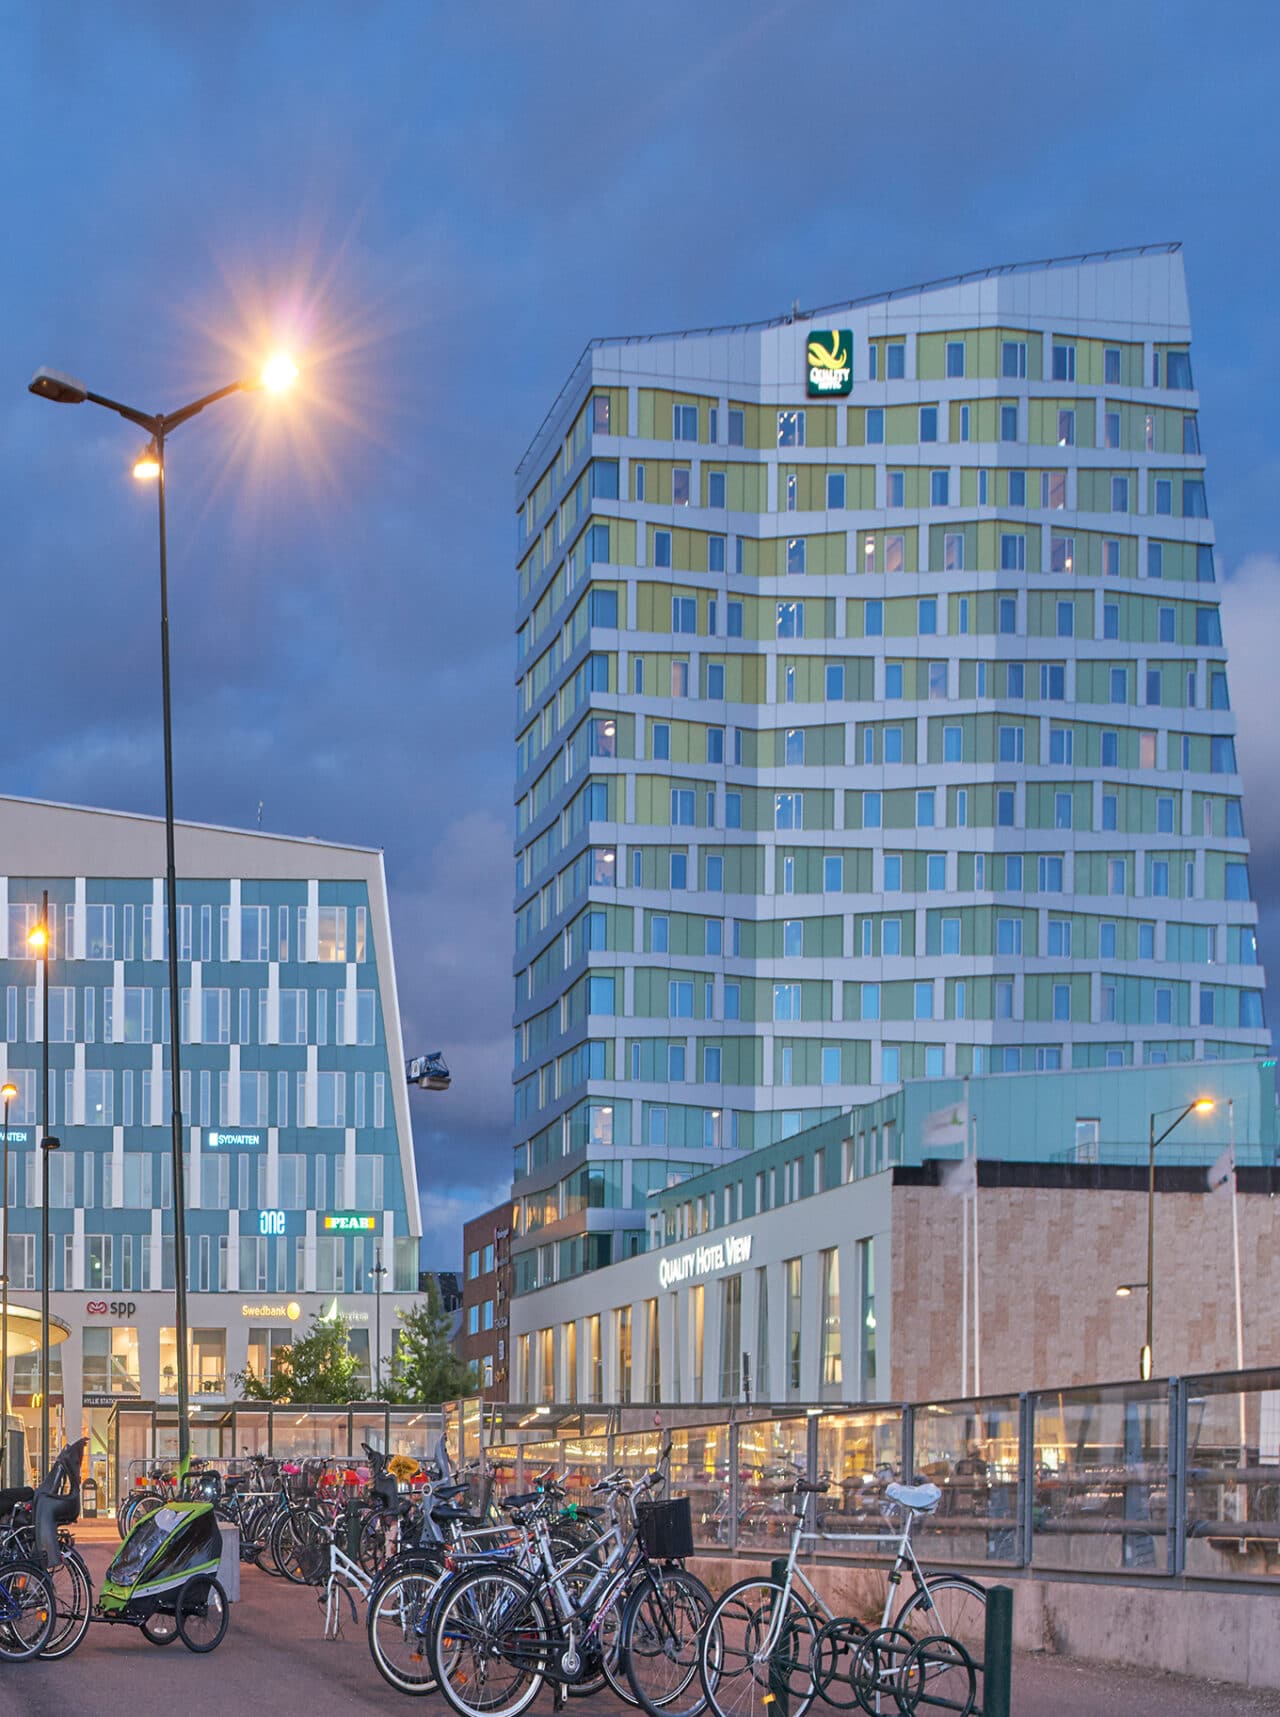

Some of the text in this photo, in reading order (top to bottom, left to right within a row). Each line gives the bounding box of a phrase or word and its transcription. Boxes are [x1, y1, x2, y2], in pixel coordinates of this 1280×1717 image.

[218, 1134, 260, 1145] SYDVATTEN
[331, 1217, 370, 1229] PEAB
[660, 1235, 752, 1289] QUALITY HOTEL VIEW
[110, 1302, 136, 1319] spp
[242, 1305, 287, 1317] Swedbank
